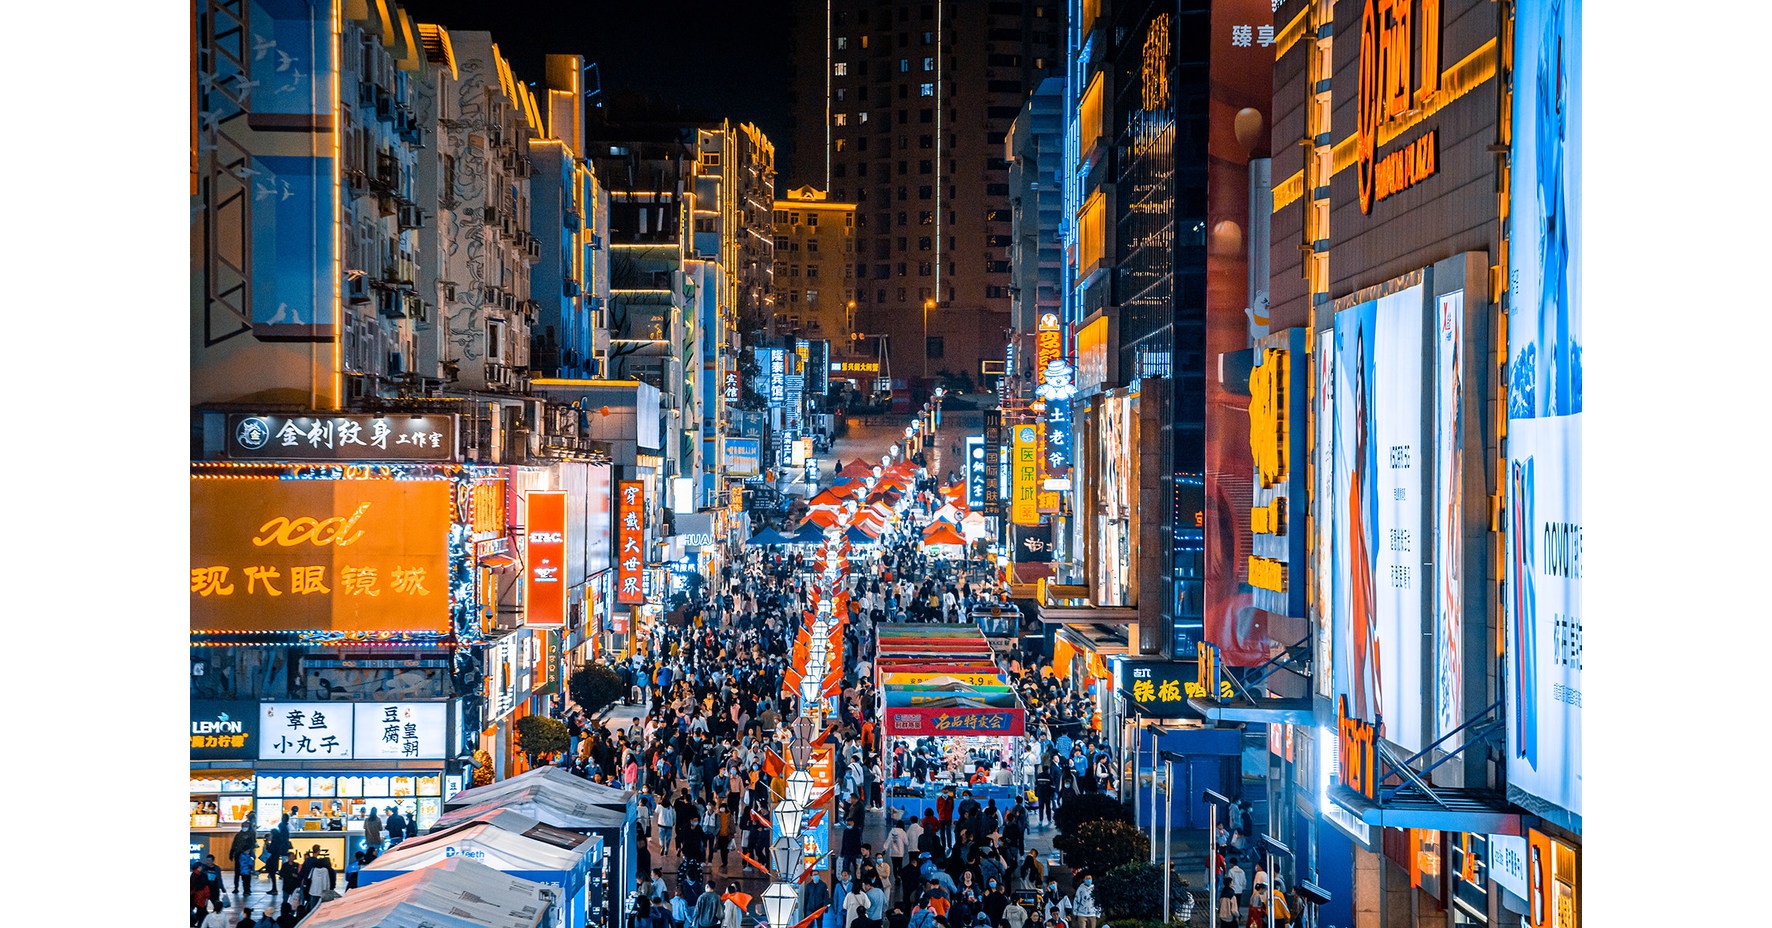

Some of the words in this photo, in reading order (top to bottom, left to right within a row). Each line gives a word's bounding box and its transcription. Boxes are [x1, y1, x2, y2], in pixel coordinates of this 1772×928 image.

[1232, 24, 1277, 47] 臻享
[1404, 130, 1435, 188] PLAZA
[726, 373, 738, 397] 宾馆
[275, 419, 391, 450] 金刺纹身
[395, 432, 444, 449] 工作室
[1048, 408, 1065, 469] 土老爷
[1020, 447, 1035, 501] 医保城
[622, 486, 641, 597] 穿戴大世界
[191, 565, 430, 597] 现代眼镜城
[192, 721, 242, 733] LEMON
[286, 709, 328, 731] 章鱼
[382, 706, 400, 743] 豆腐
[935, 712, 1004, 730] 名品特卖会
[273, 735, 340, 754] 小丸子
[401, 723, 419, 757] 皇朝
